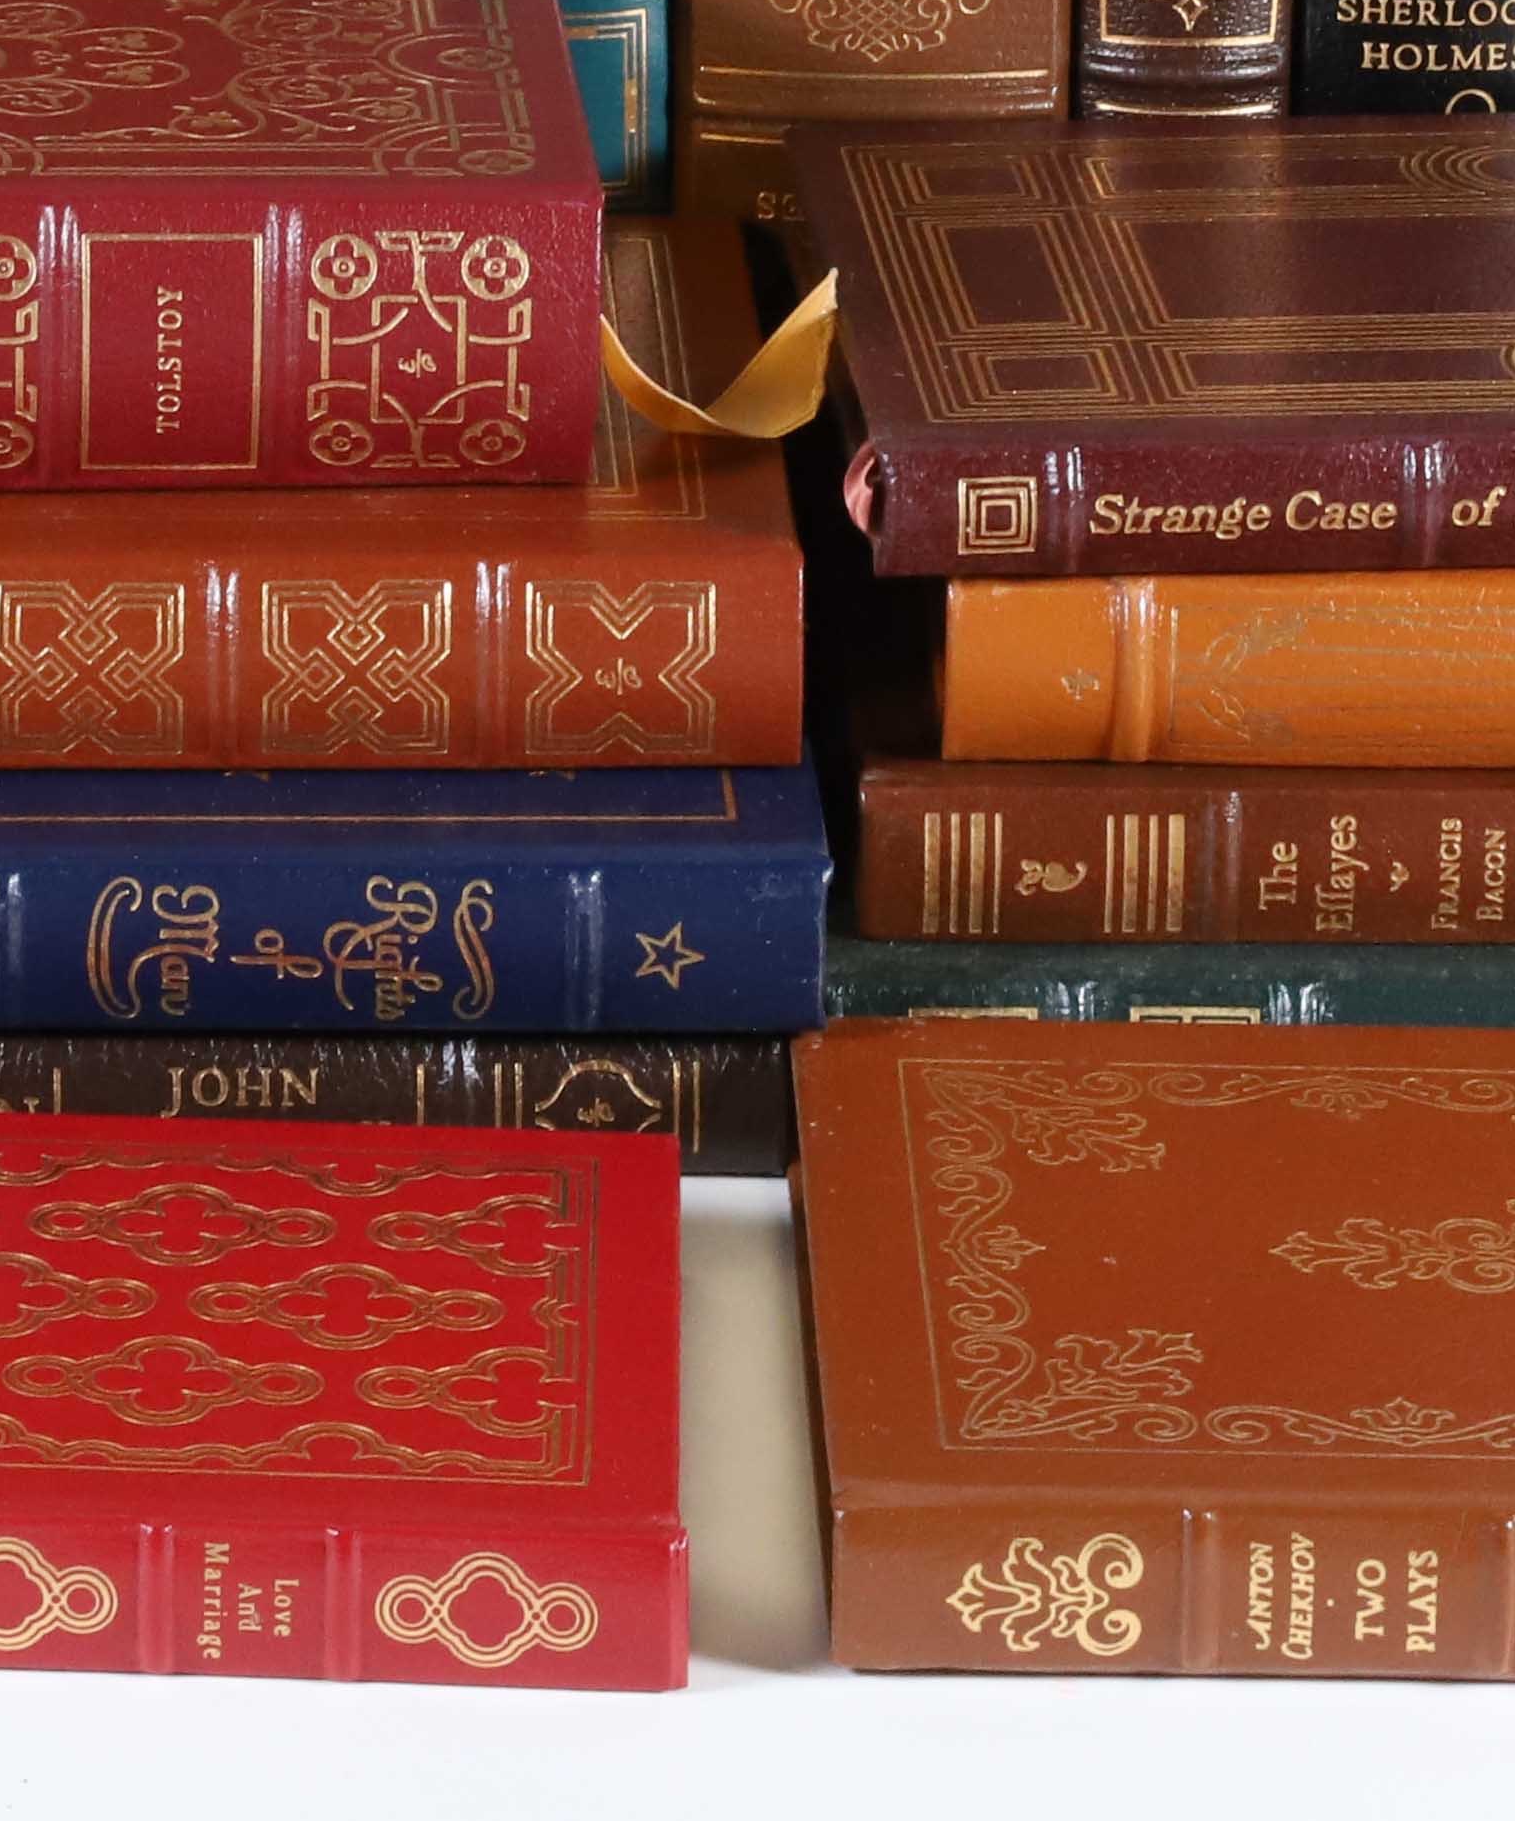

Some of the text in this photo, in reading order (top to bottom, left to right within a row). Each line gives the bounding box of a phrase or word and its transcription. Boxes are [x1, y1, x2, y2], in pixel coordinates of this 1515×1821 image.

[156, 284, 185, 436] TOLSTOY
[1088, 493, 1273, 540] Strange
[1283, 489, 1399, 530] Case
[1258, 840, 1298, 913] The
[1430, 815, 1464, 931] FRANCIS
[1475, 827, 1508, 923] BACON
[142, 883, 222, 1017] Man
[322, 873, 444, 1022] Rights
[159, 1065, 320, 1120] JOHN
[196, 1541, 231, 1660] Marriage
[272, 1577, 301, 1638] Love
[1245, 1540, 1274, 1652] ANTON
[1280, 1530, 1316, 1661] CHEKHOV
[1354, 1557, 1388, 1643] TWO
[1404, 1548, 1440, 1655] PLAYS
